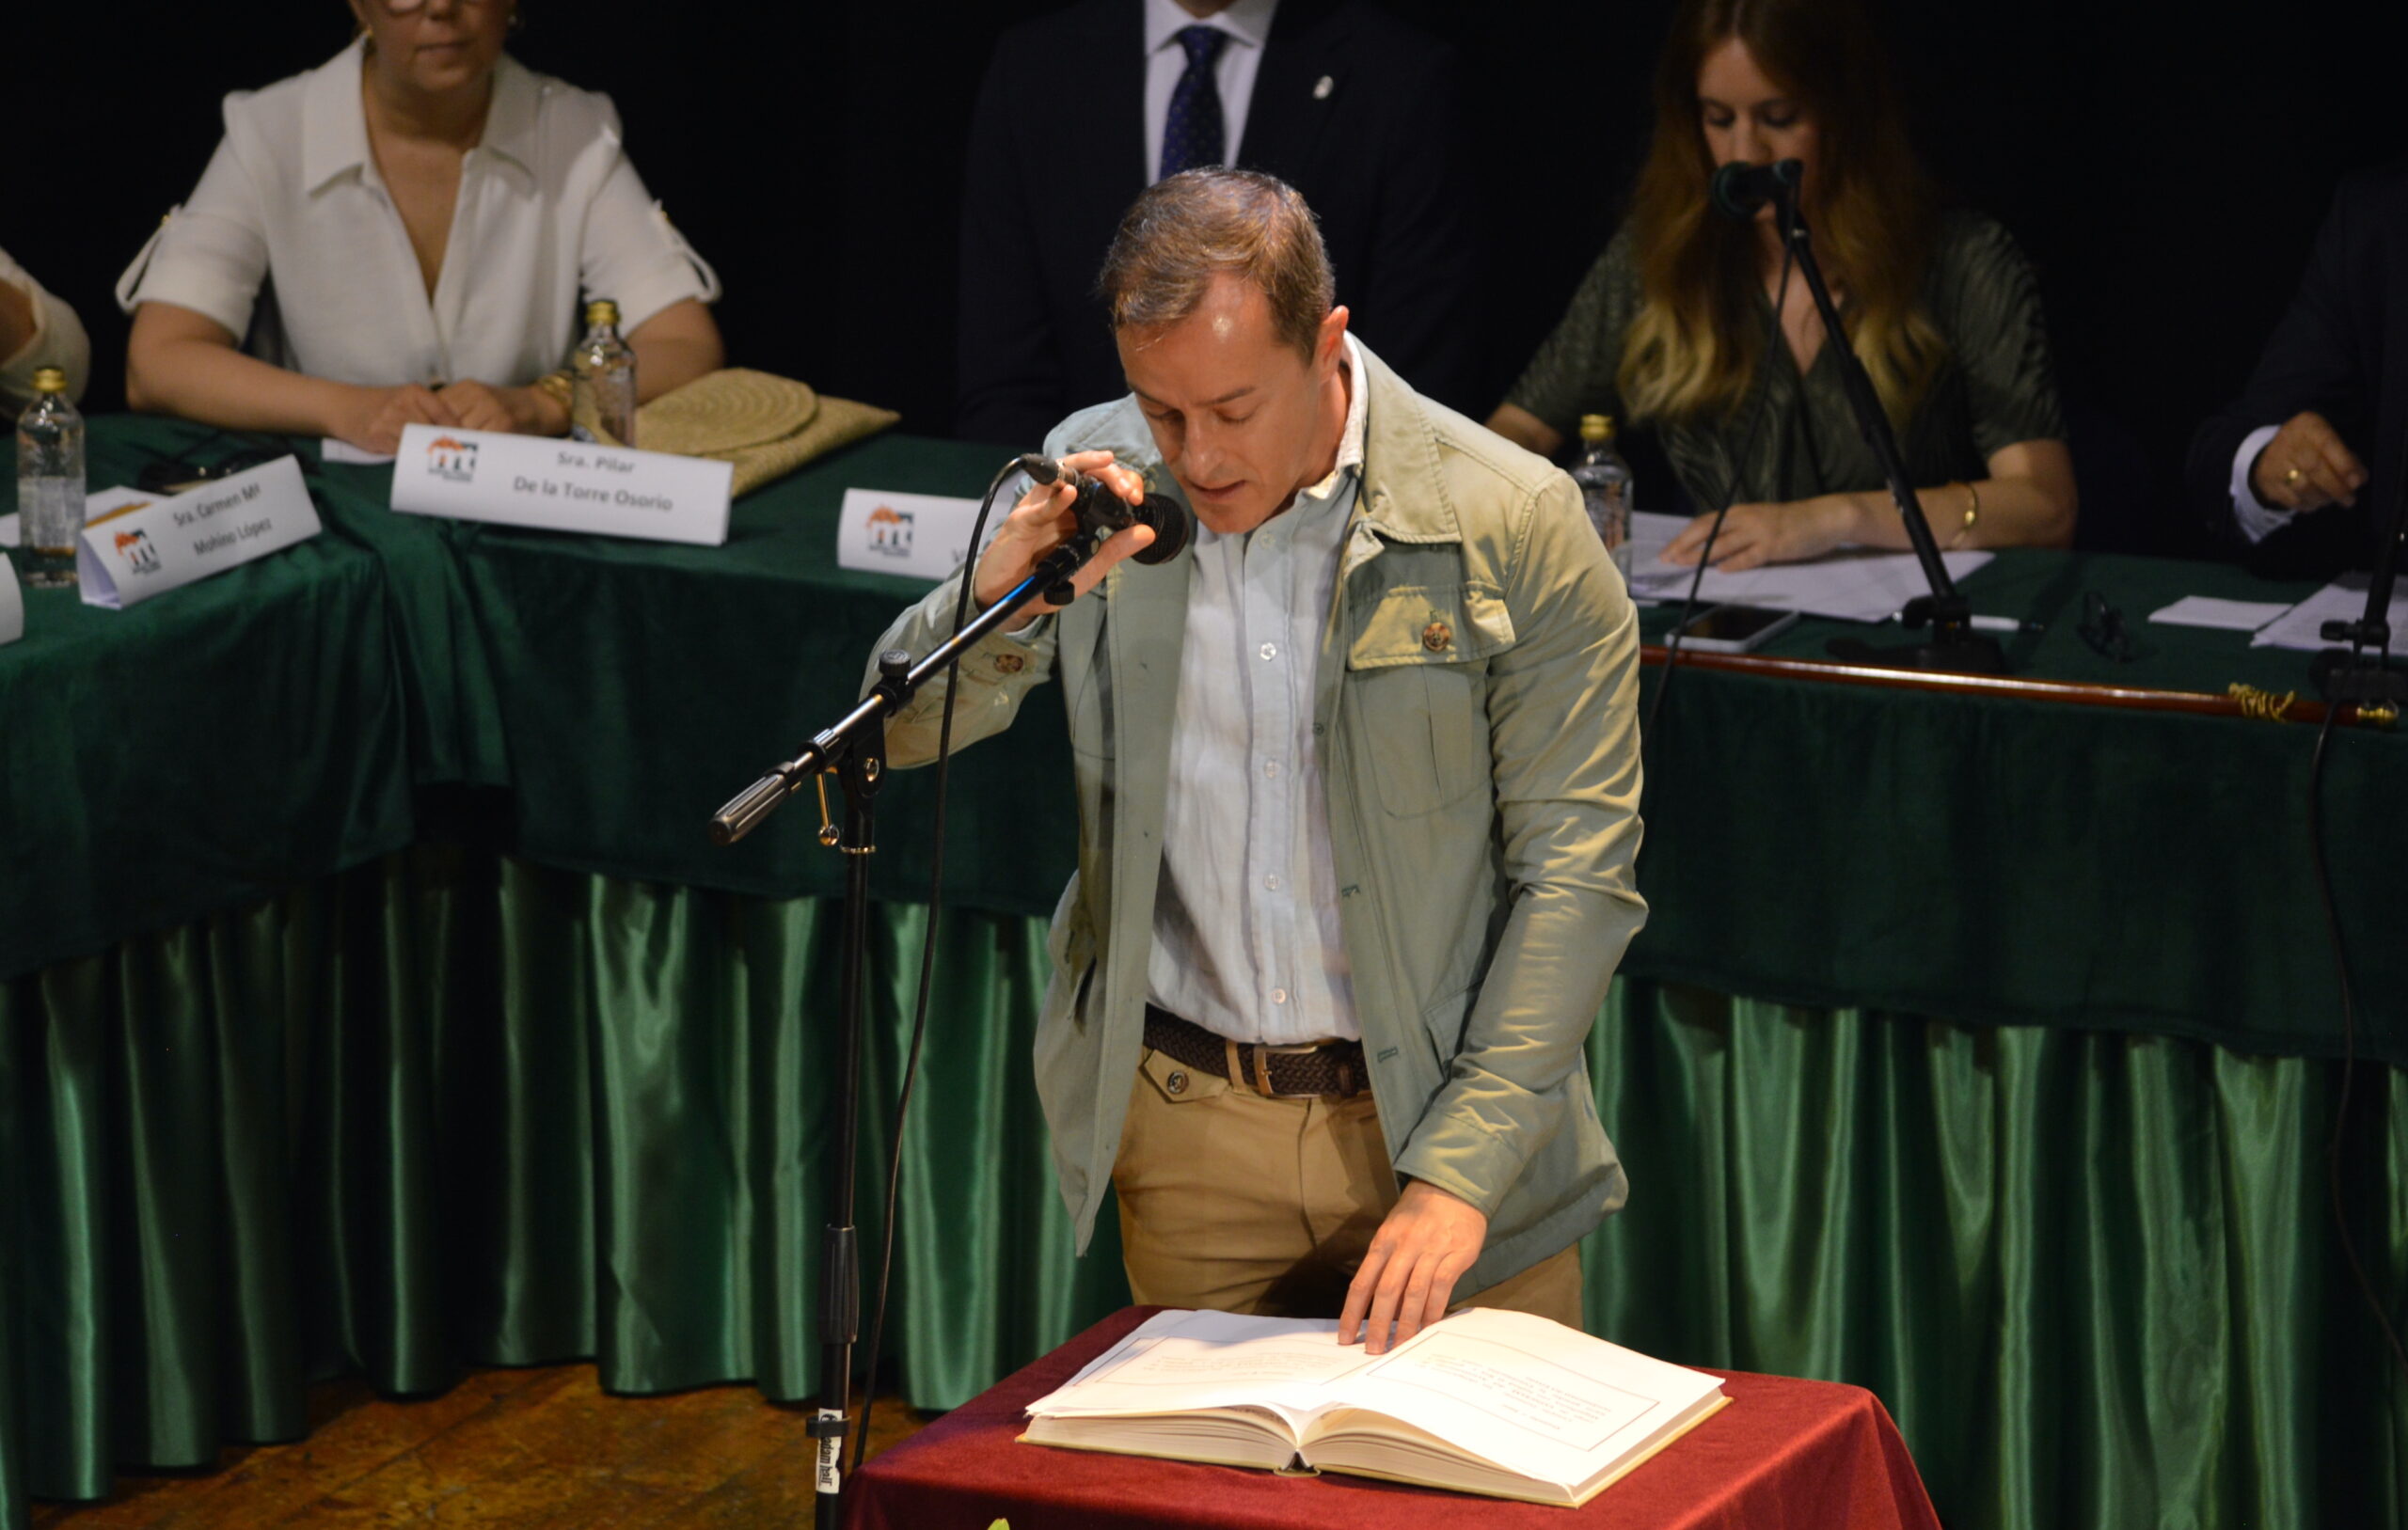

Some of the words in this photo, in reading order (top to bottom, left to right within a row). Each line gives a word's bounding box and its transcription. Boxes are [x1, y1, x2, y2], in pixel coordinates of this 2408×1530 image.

[557, 450, 590, 467] Sra.
[595, 455, 636, 473] Pilar
[514, 475, 537, 493] De
[543, 479, 558, 496] la
[564, 481, 610, 503] Torre
[615, 488, 674, 512] Osorio
